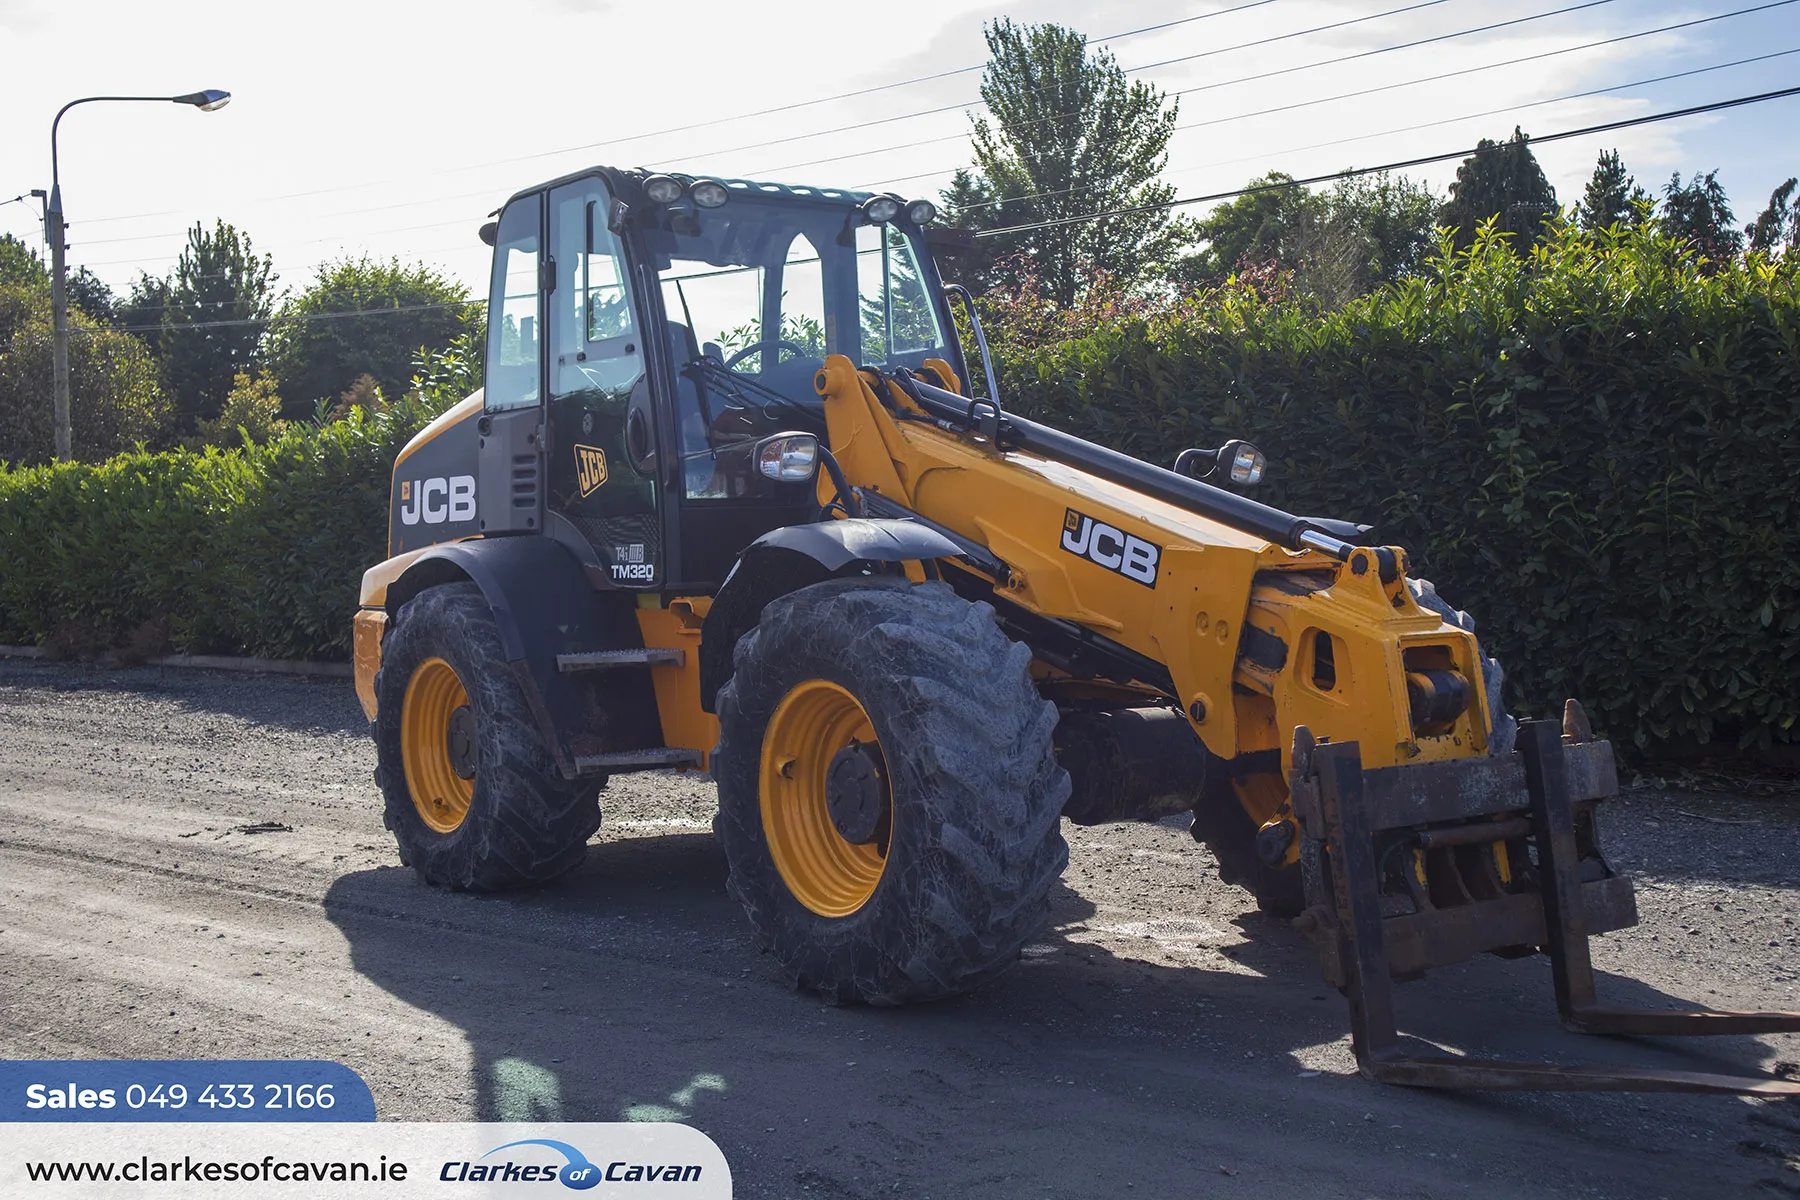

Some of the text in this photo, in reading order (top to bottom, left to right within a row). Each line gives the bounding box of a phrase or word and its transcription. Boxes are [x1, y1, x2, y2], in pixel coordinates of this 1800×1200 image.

[580, 449, 606, 491] JCB
[401, 475, 476, 525] JCB
[611, 564, 654, 579] TM320
[1062, 516, 1158, 584] JCB
